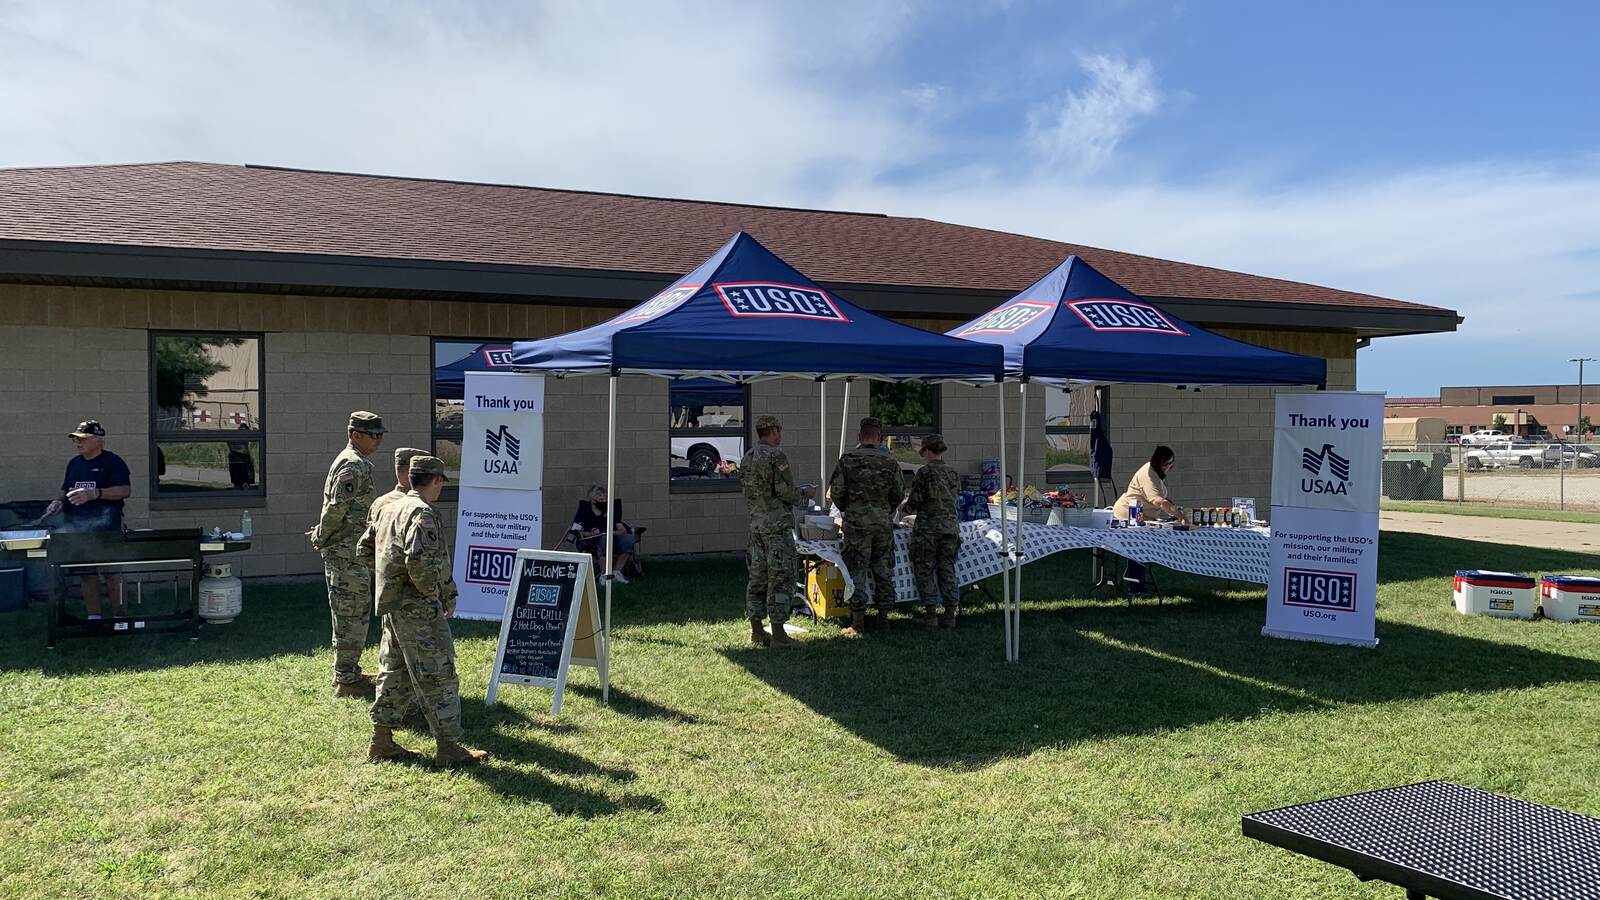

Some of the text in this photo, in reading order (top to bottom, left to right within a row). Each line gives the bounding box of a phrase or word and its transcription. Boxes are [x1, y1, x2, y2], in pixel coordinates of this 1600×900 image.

[743, 288, 817, 314] USO
[1090, 304, 1160, 328] USO
[475, 395, 534, 412] Thank you
[1289, 414, 1369, 431] Thank you
[484, 459, 518, 474] USAA
[1301, 478, 1347, 495] USAA
[462, 509, 473, 517] For
[473, 511, 508, 521] supporting
[519, 514, 539, 522] USO's
[468, 521, 495, 530] mission,
[507, 523, 532, 533] military
[484, 531, 500, 539] their
[500, 532, 527, 541] families!
[1289, 533, 1332, 543] supporting
[1333, 535, 1347, 543] the
[1348, 536, 1373, 545] USO's
[1283, 543, 1315, 552] mission,
[1332, 545, 1363, 556] military
[480, 553, 513, 579] USO
[1303, 553, 1322, 561] their
[1324, 555, 1358, 565] families!
[524, 560, 566, 579] WELCOME
[481, 586, 508, 597] USO.org
[535, 588, 552, 601] USO
[1300, 575, 1341, 604] USO
[516, 606, 563, 621] GRILL CHILL
[1303, 609, 1337, 621] USO.org
[512, 620, 518, 631] 2
[518, 620, 530, 631] Hot
[530, 620, 545, 632] Dogs
